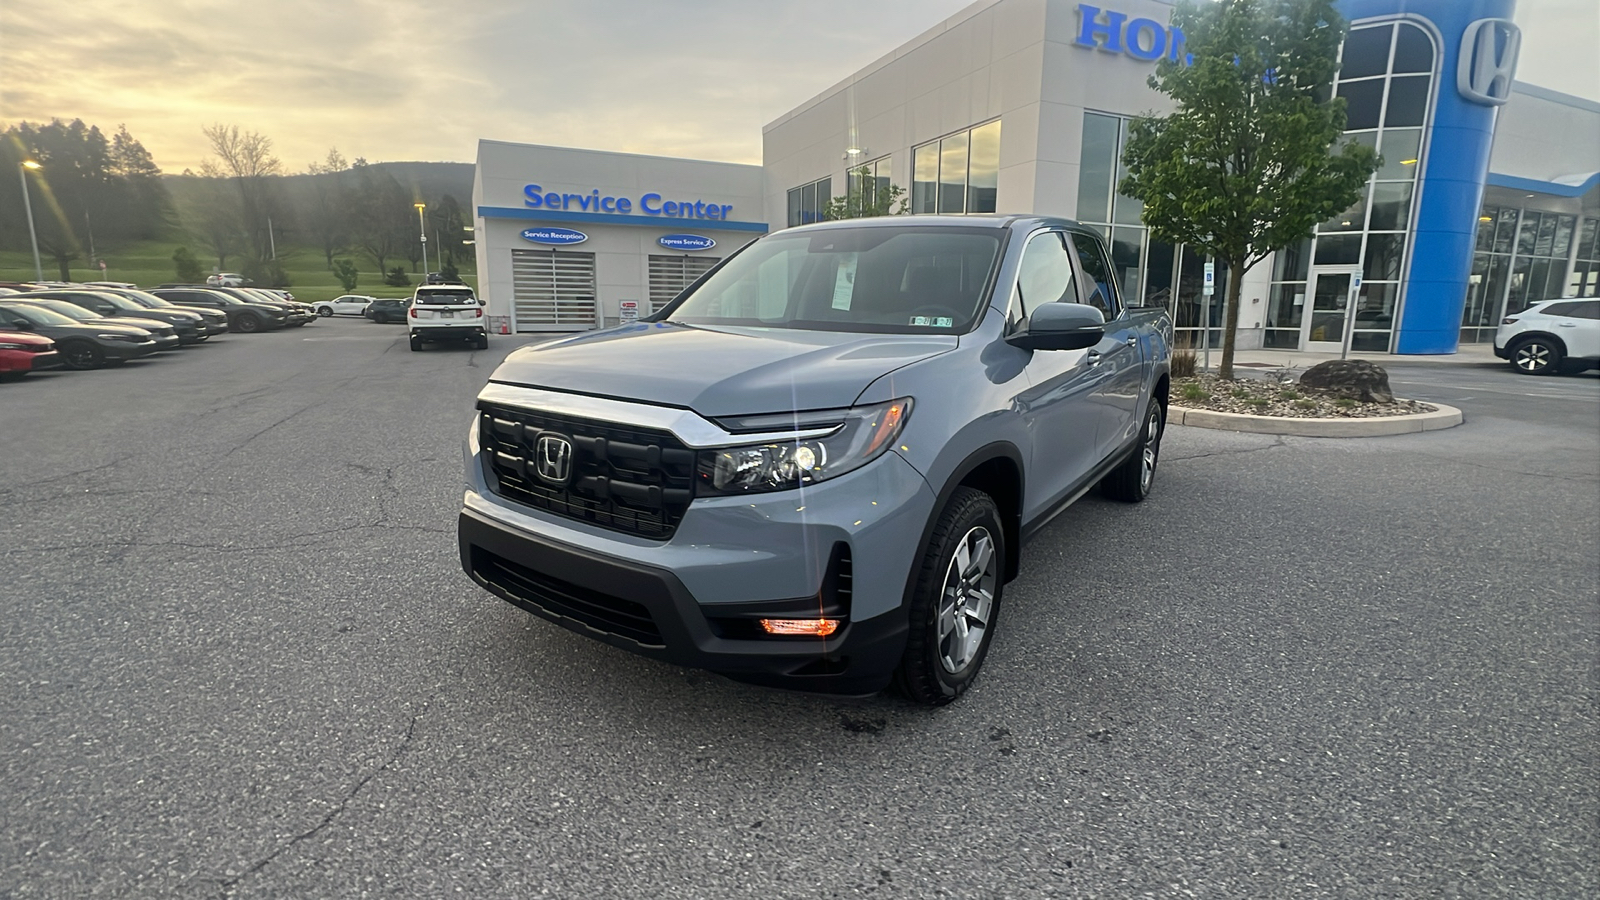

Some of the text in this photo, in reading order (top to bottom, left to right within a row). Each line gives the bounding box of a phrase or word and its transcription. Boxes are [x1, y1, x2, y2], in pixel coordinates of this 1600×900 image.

[523, 184, 733, 219] Service Center
[550, 232, 584, 240] Reception
[660, 237, 704, 246] Express Service
